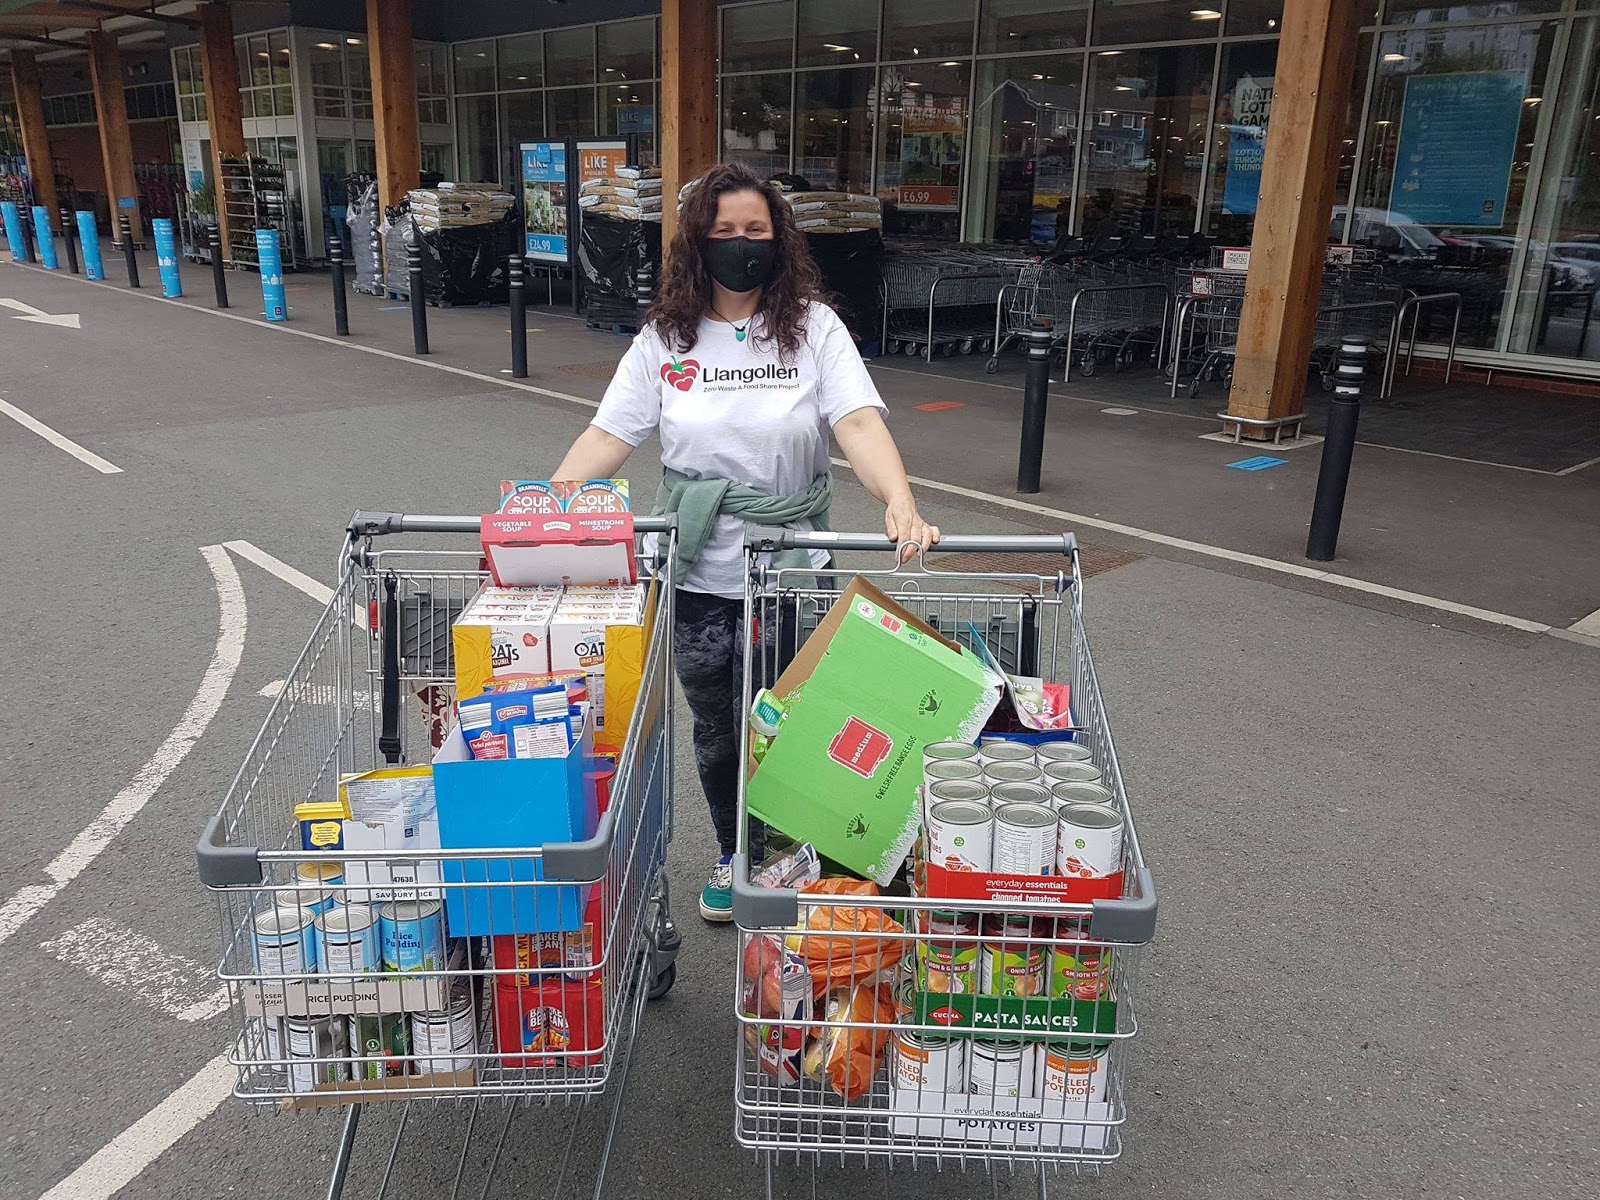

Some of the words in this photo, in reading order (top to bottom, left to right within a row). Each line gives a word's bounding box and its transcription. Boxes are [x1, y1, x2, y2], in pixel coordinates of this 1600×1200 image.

[1241, 88, 1273, 100] NATI
[1240, 102, 1272, 114] LOT
[1239, 114, 1269, 126] GAM
[1235, 148, 1261, 156] LOTTO
[584, 155, 607, 169] LIKE
[1234, 156, 1262, 164] EUROM
[903, 191, 930, 203] £6.99
[529, 239, 551, 251] £24.99
[702, 363, 799, 383] Llangollen
[513, 496, 552, 506] SOUP
[578, 495, 616, 506] SOUP
[574, 642, 605, 656] OAT
[851, 732, 873, 764] medium
[888, 762, 900, 781] FREE
[896, 748, 909, 767] RANGE
[906, 735, 917, 751] EGGS
[986, 879, 1024, 889] everyday
[1025, 881, 1068, 890] essentials
[307, 995, 331, 1003] RICE
[333, 992, 379, 1003] PUDDING
[974, 1012, 1019, 1025] PASTA
[1024, 1013, 1079, 1027] SAUCES
[899, 1059, 920, 1074] ELED
[899, 1068, 928, 1084] ATOES
[1051, 1074, 1088, 1087] PEELED
[995, 1110, 1042, 1119] essentials
[958, 1118, 1036, 1132] POTATOES
